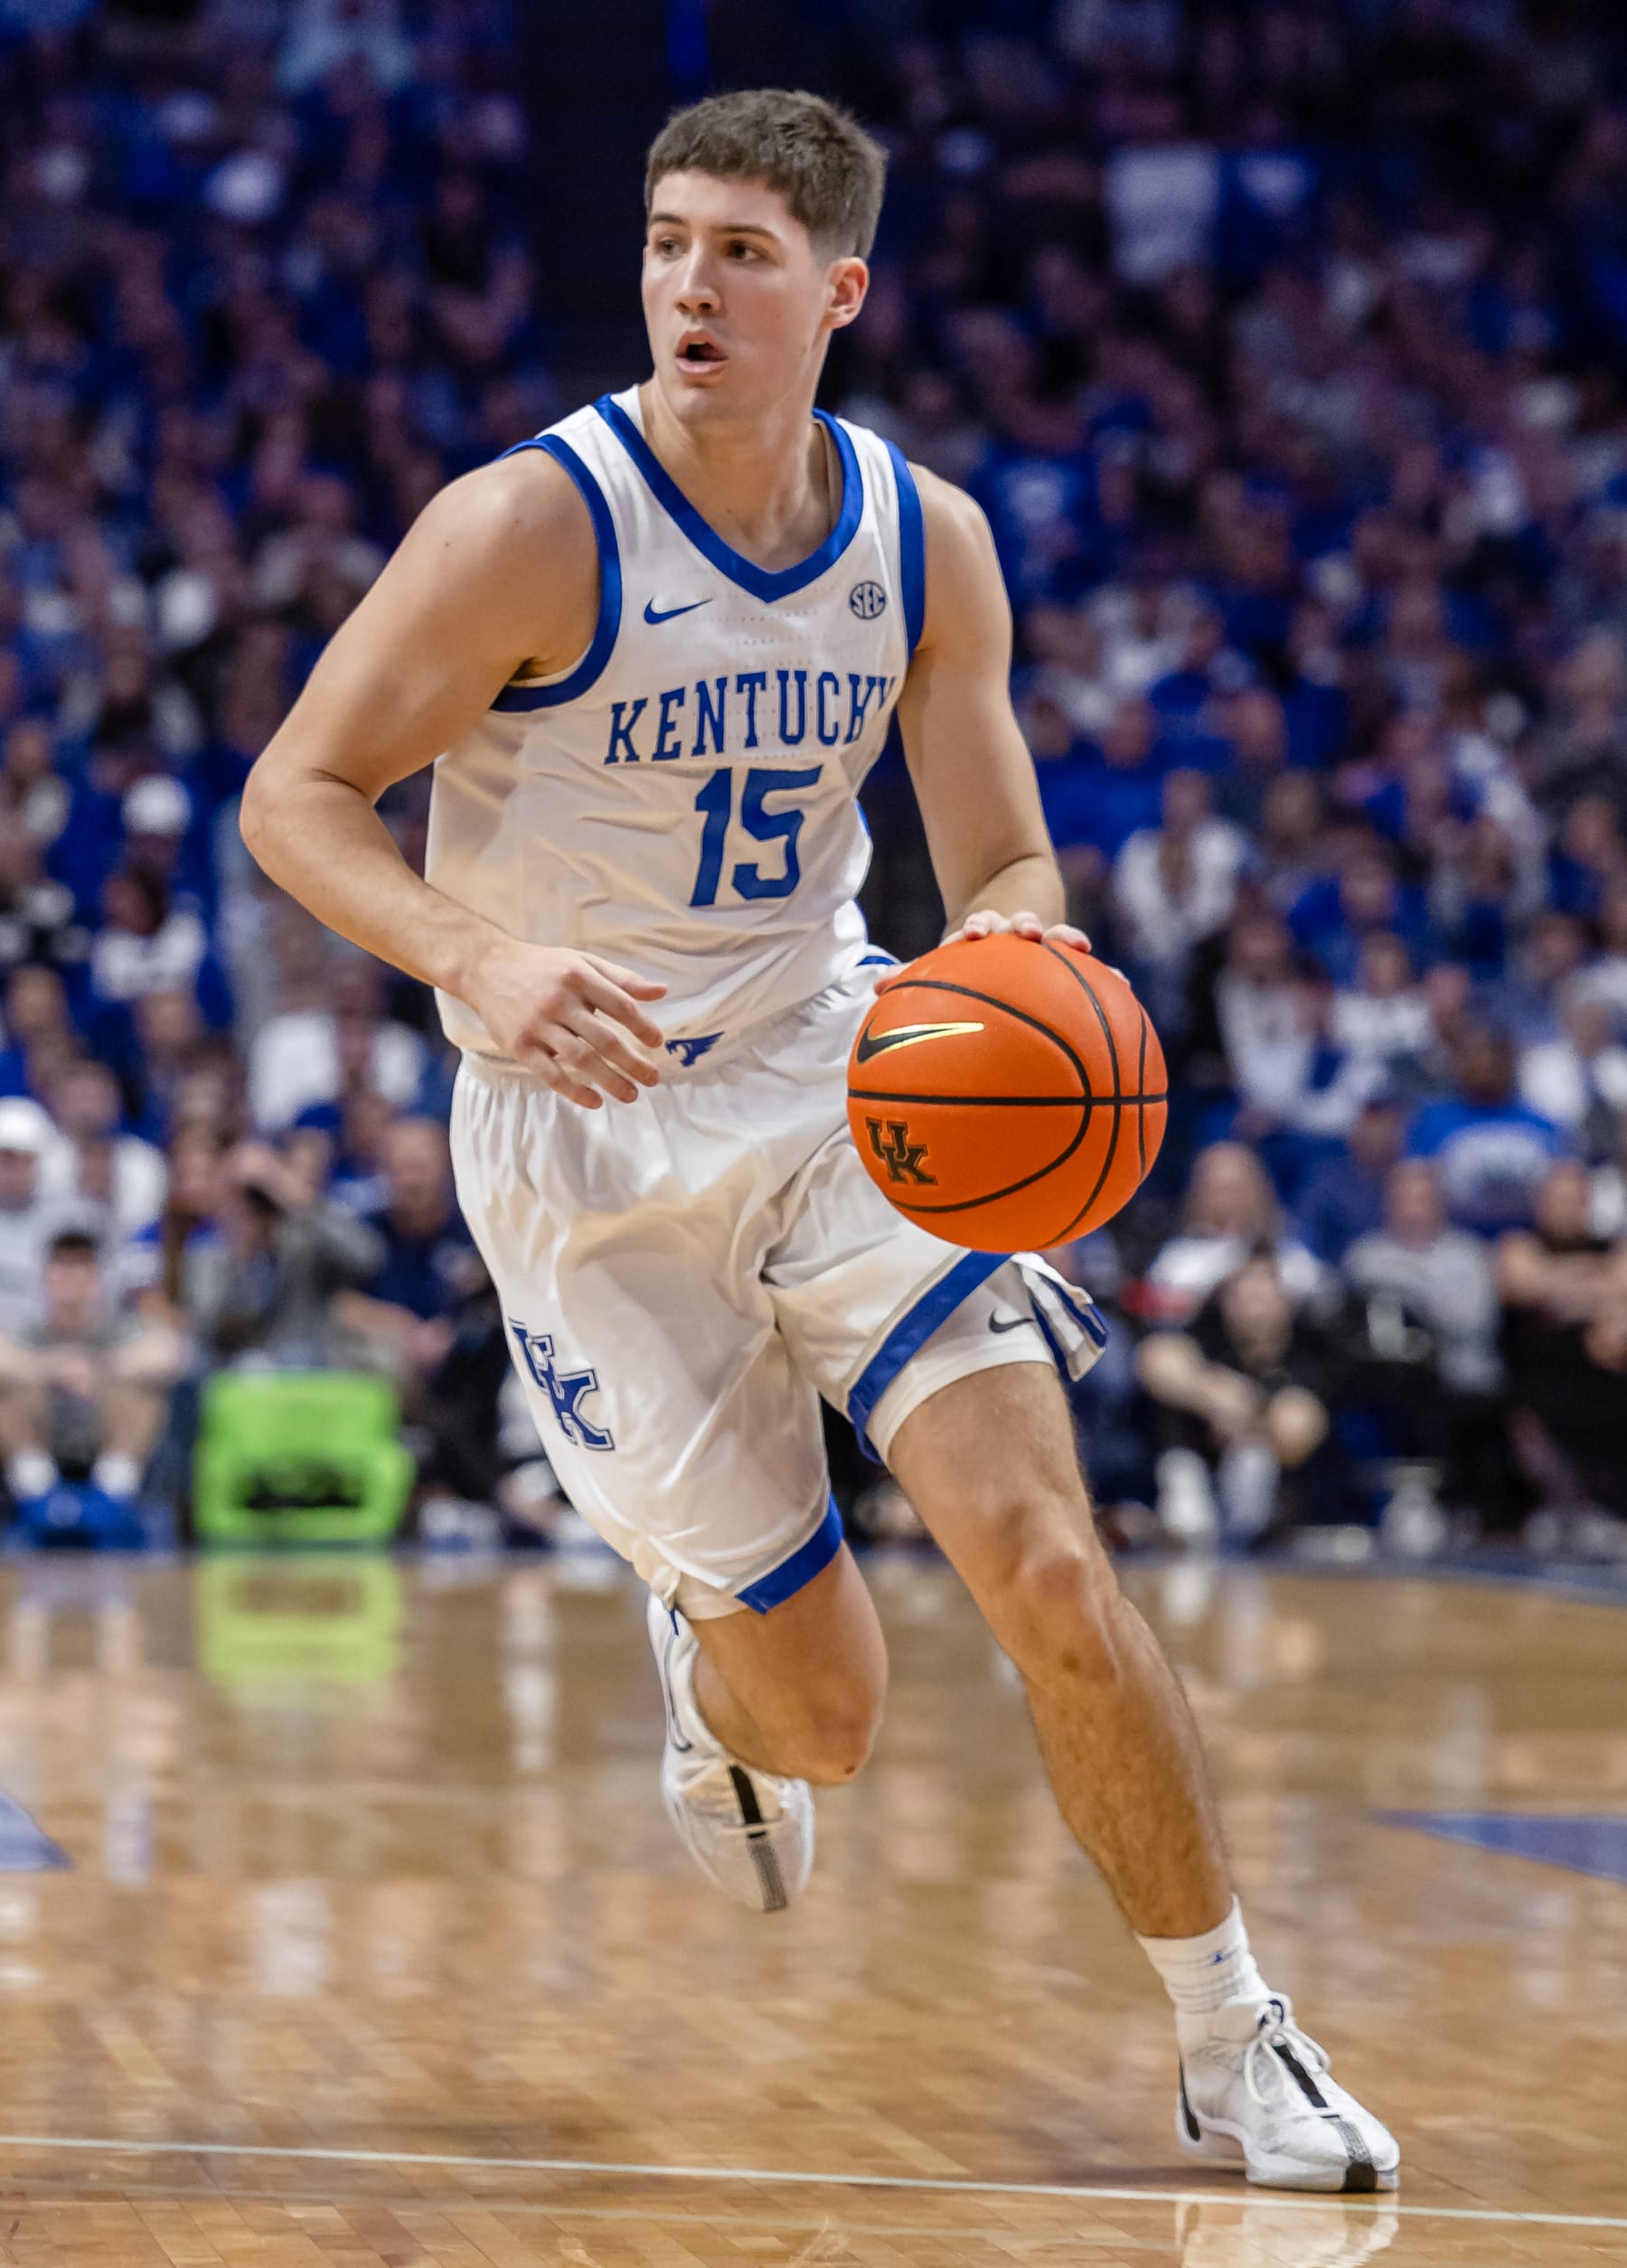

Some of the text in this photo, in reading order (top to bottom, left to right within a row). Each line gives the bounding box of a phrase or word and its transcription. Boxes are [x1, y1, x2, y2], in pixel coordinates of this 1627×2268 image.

[850, 582, 886, 619] SEC
[690, 765, 823, 907] 15
[865, 1116, 938, 1186] UK
